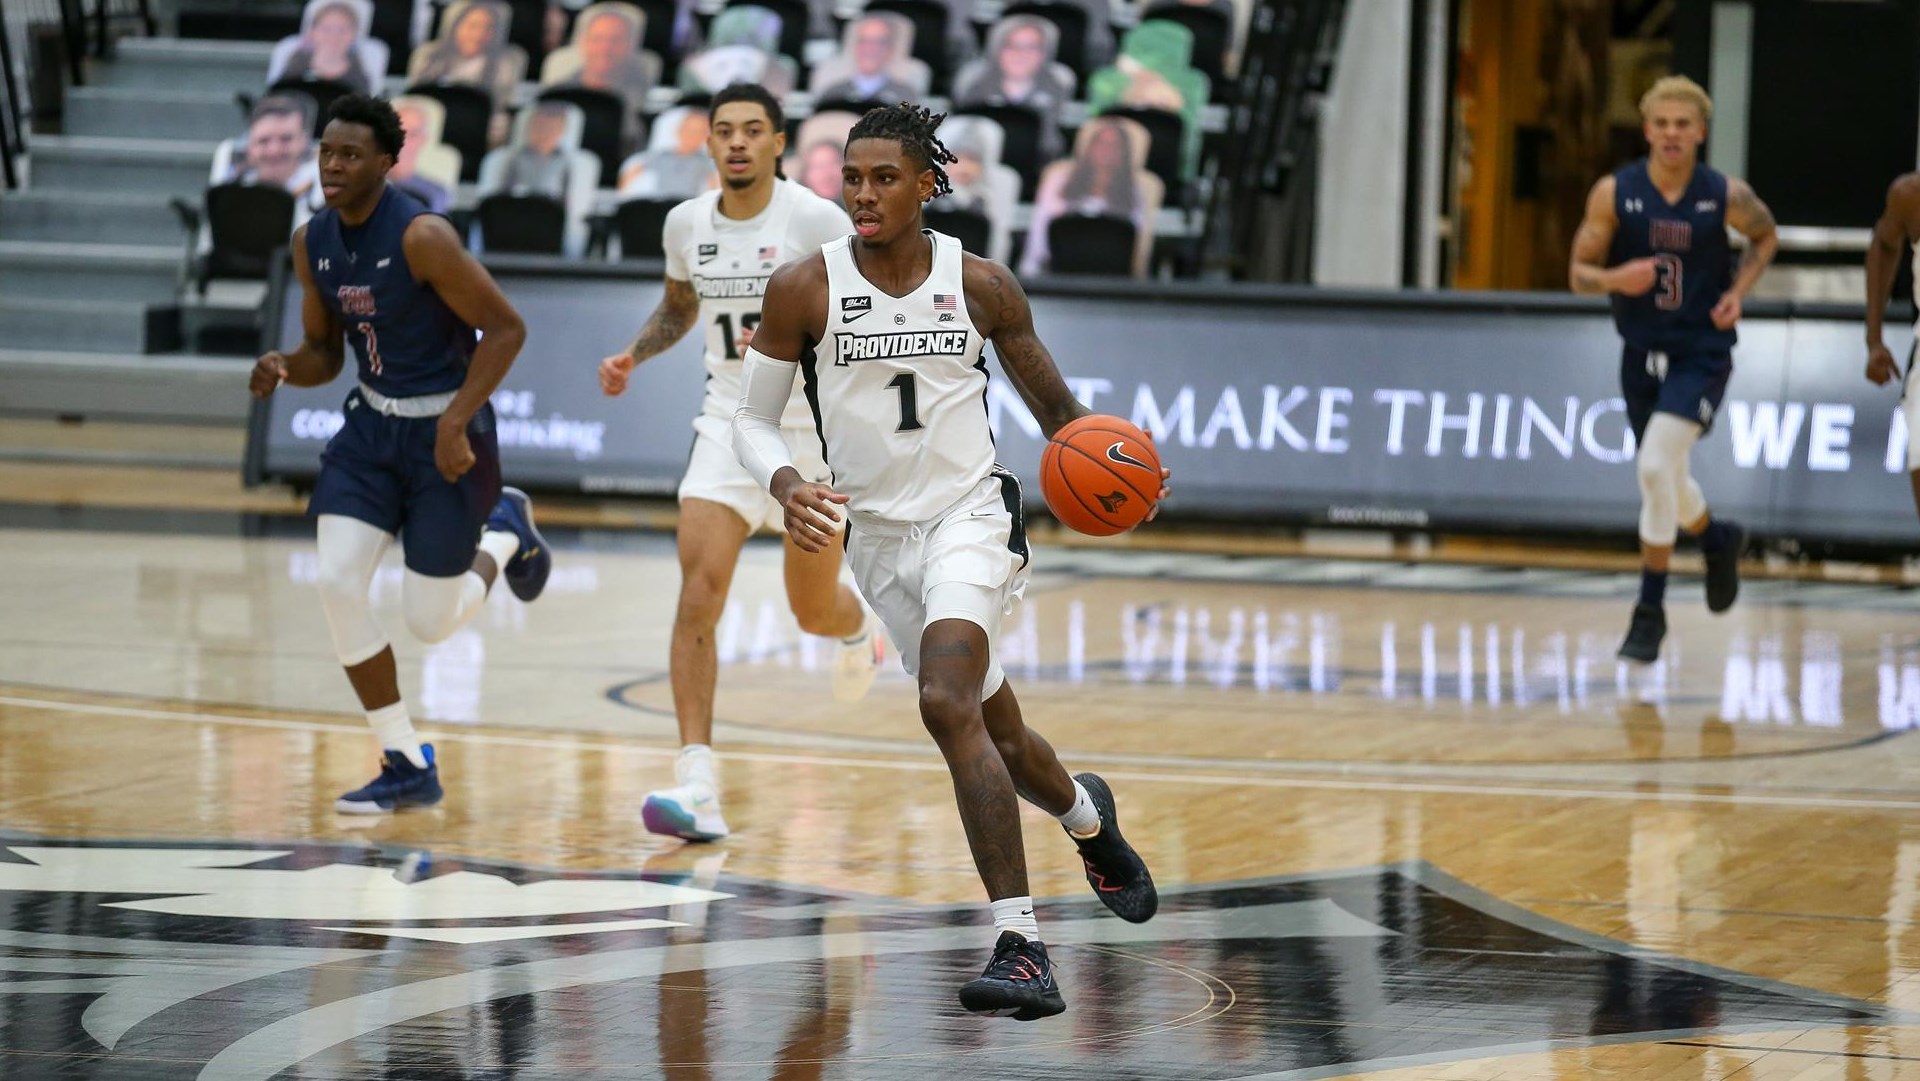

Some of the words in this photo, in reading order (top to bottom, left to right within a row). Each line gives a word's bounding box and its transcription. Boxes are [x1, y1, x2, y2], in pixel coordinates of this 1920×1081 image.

[692, 273, 769, 300] PROVIDEN
[844, 298, 868, 307] BLM
[1655, 254, 1683, 311] 3
[358, 322, 383, 376] 1
[834, 329, 968, 367] PROVIDENCE
[883, 371, 924, 433] 1
[1131, 383, 1354, 454] MAKE
[1374, 388, 1636, 463] THING
[1728, 400, 1855, 471] WE
